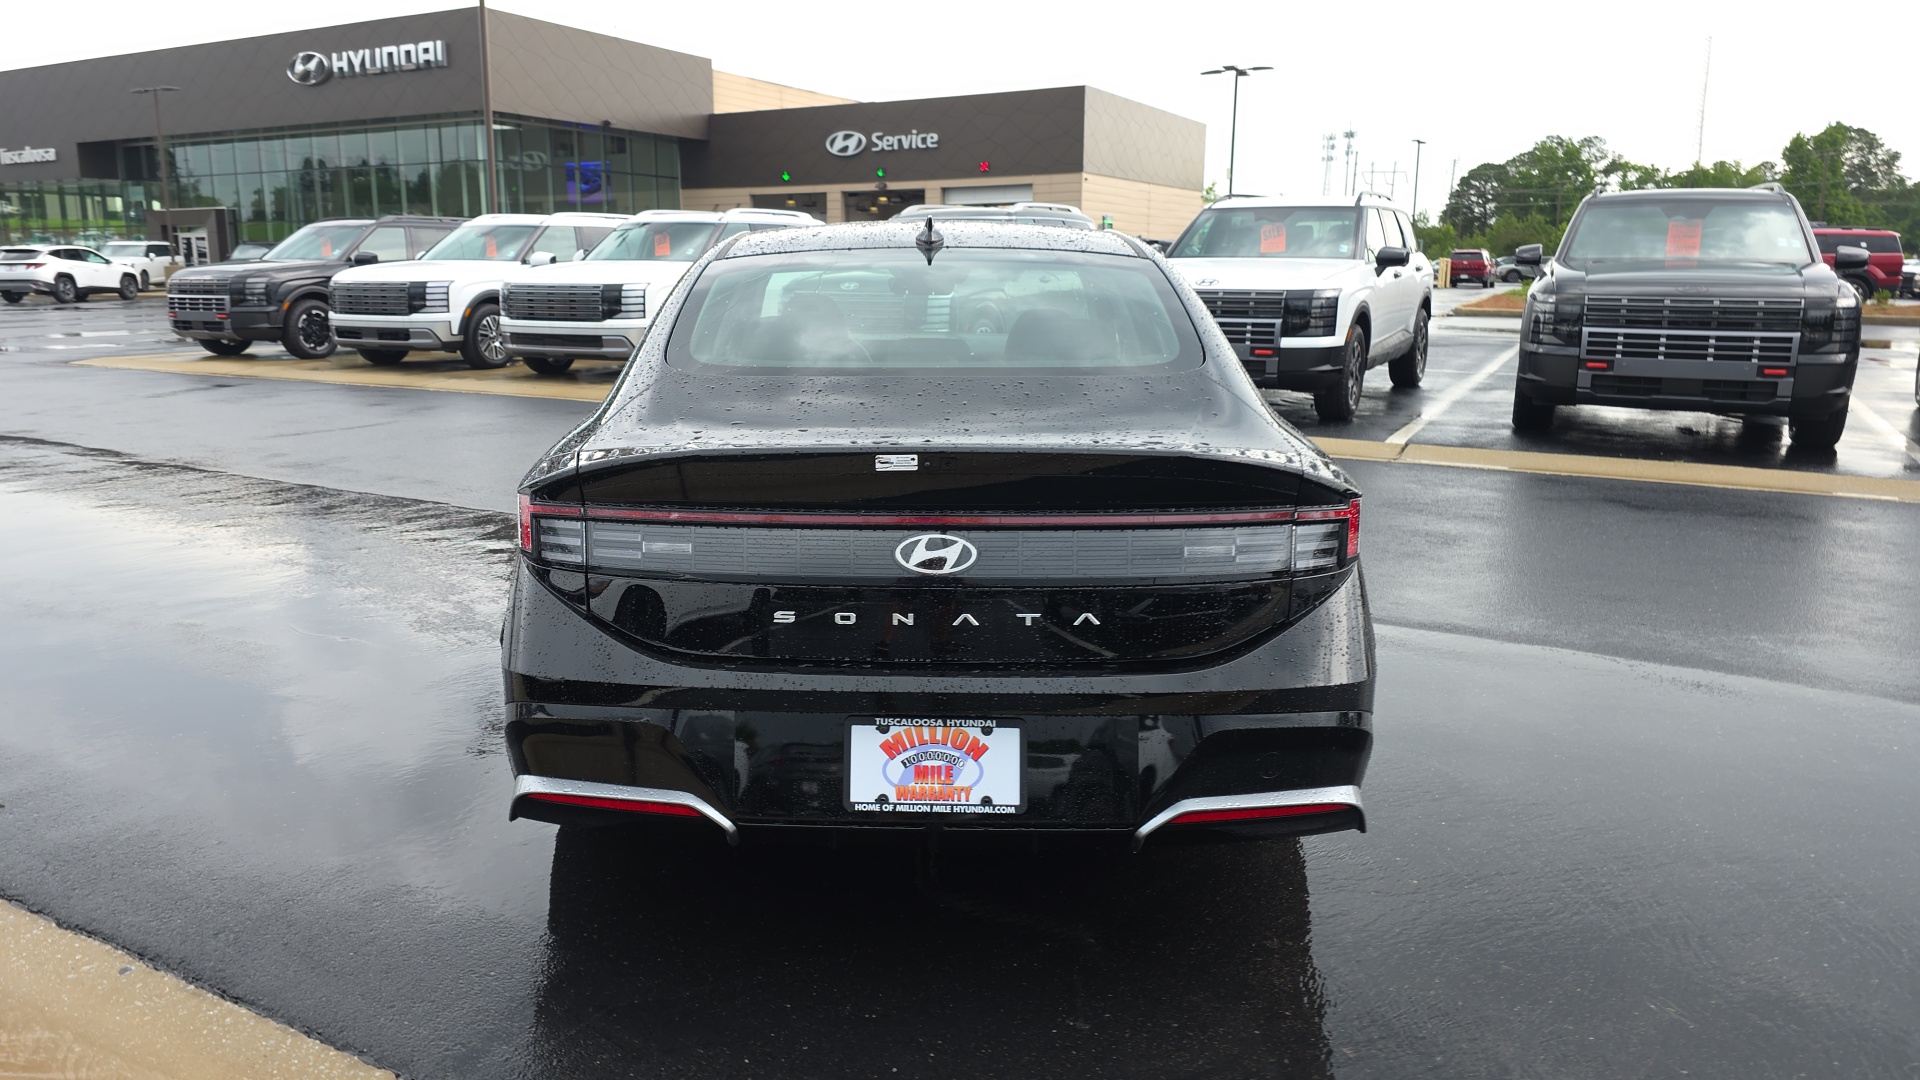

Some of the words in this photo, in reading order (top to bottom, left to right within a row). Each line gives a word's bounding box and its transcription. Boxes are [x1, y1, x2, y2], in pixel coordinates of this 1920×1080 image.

[331, 39, 447, 78] HYUNDAI
[871, 129, 939, 152] Service
[773, 610, 1101, 626] SONATA
[875, 717, 944, 727] TUSCALOOSA
[947, 719, 996, 728] HYUNDAI
[879, 726, 989, 761] MILLION
[914, 764, 954, 785] MILE
[895, 785, 972, 802] WARRANTY
[854, 803, 881, 812] HOME
[882, 804, 895, 812] OF
[896, 804, 931, 813] MILLION
[932, 804, 952, 813] MILE
[953, 805, 1016, 814] HYUNDAI.COM
